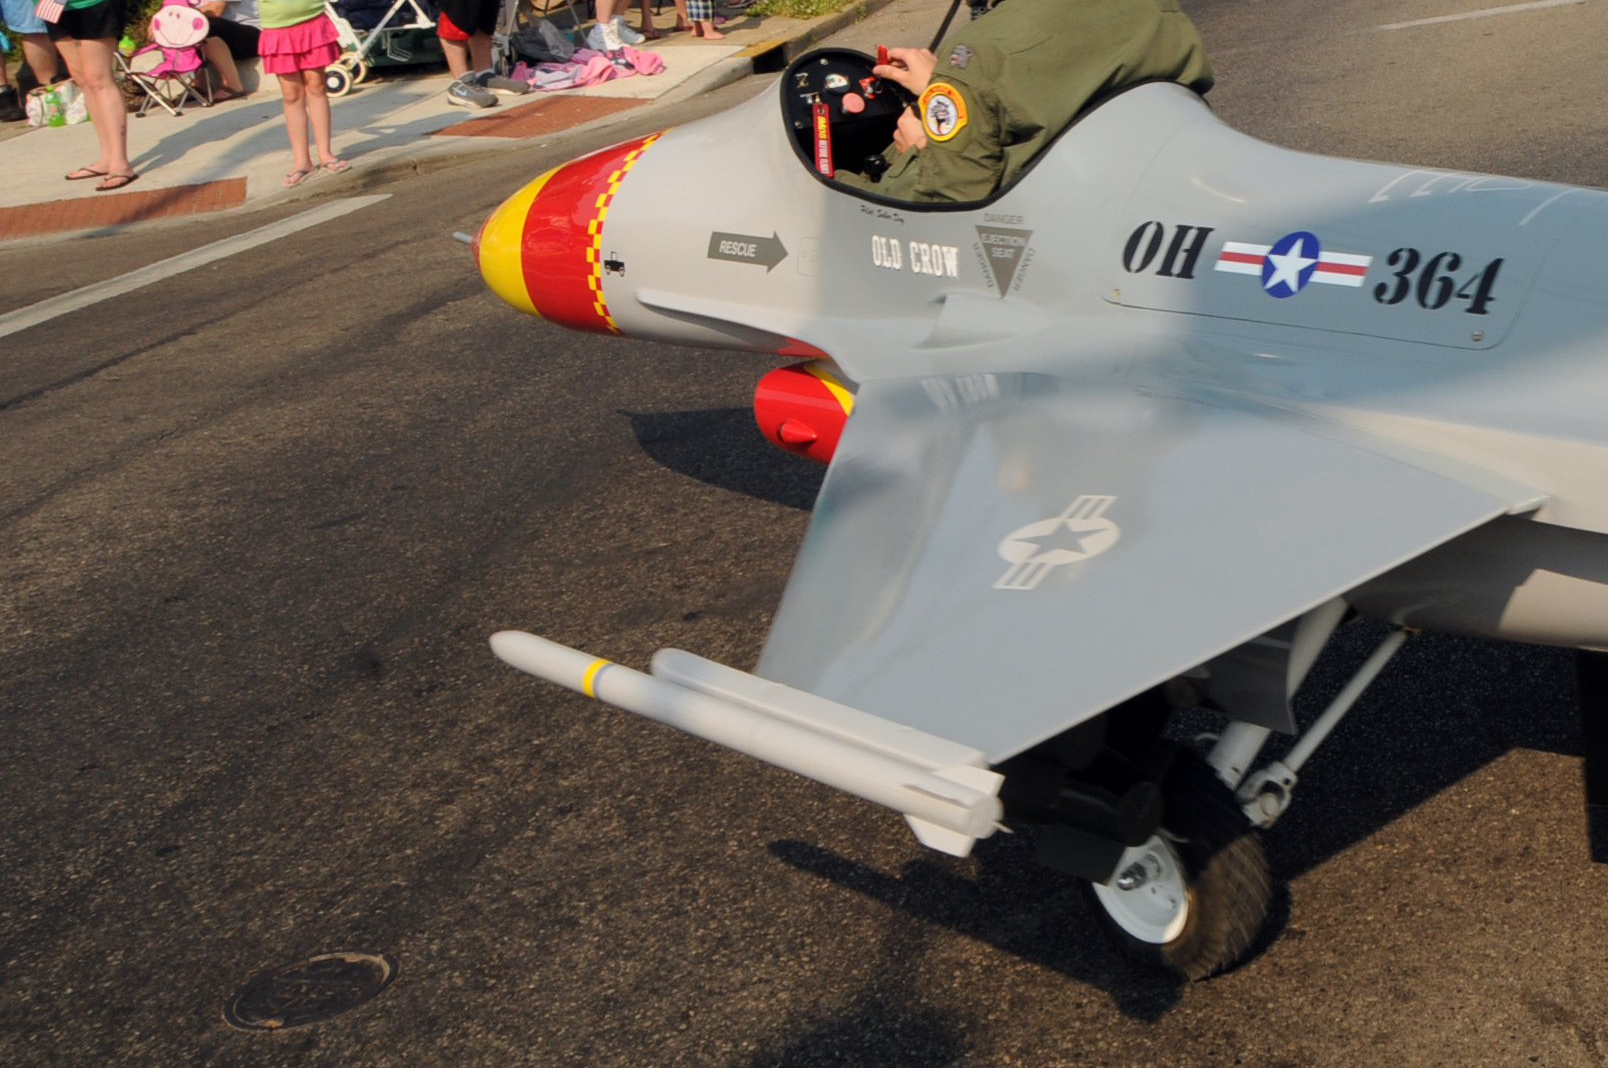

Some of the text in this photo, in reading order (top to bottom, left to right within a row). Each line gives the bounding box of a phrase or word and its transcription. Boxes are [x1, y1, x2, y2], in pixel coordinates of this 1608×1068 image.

[983, 212, 1024, 225] DANGER
[719, 240, 757, 258] RESCUE
[981, 233, 1026, 246] EJECTION
[992, 247, 1016, 260] SEAT
[871, 234, 960, 278] OLD CROW
[973, 242, 995, 289] DANGER
[1011, 247, 1037, 292] DANGER
[1121, 220, 1505, 316] OH 364
